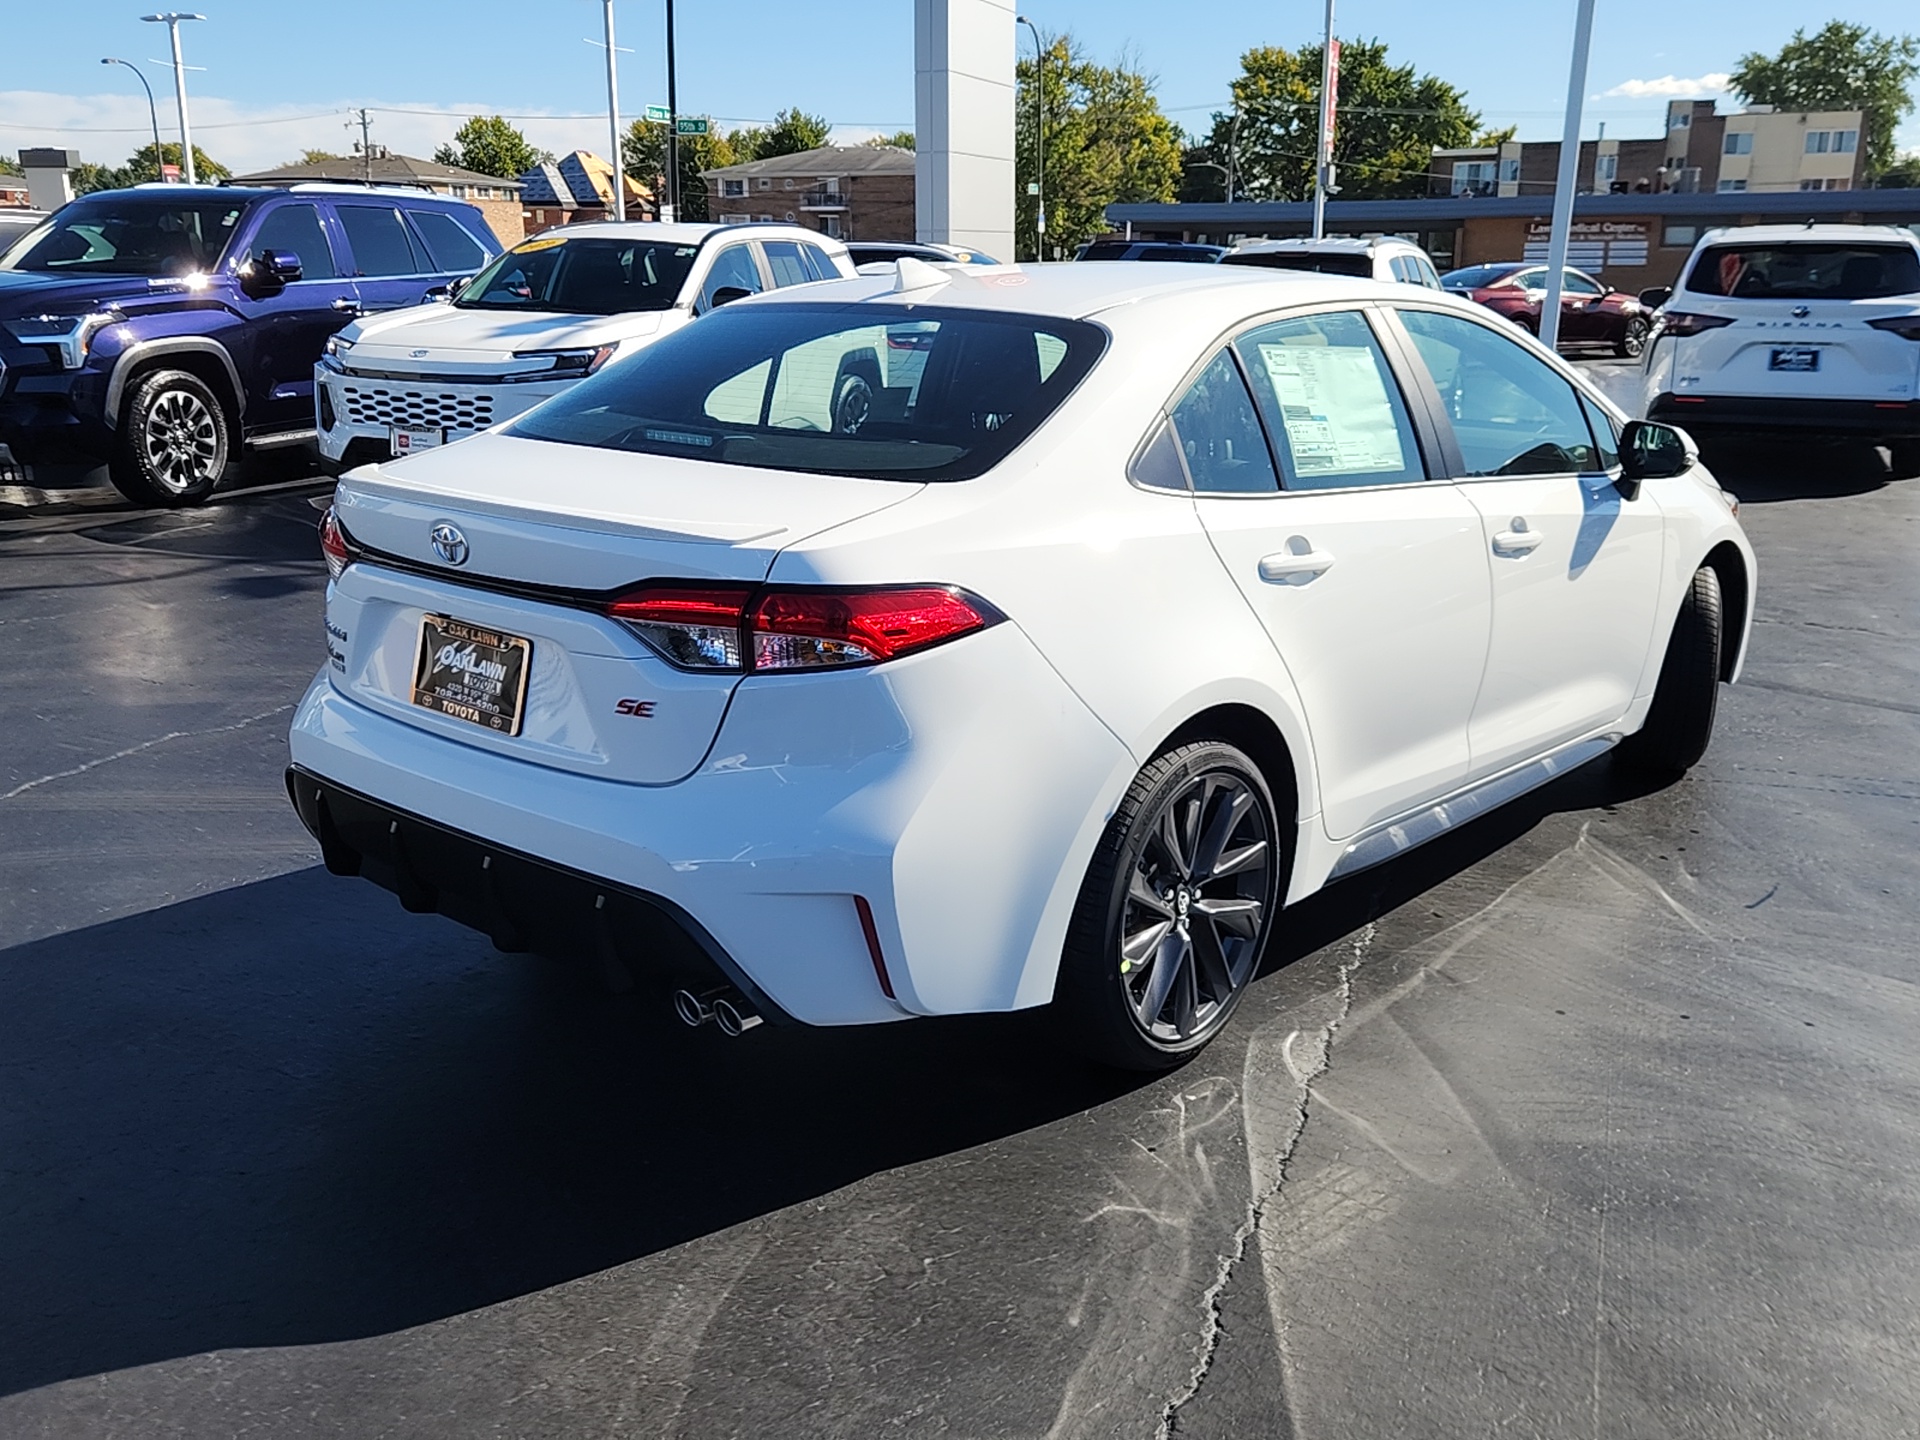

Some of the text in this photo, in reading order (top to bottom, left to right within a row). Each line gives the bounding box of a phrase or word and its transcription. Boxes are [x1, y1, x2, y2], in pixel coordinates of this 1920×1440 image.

[679, 122, 705, 131] 95th St
[1602, 222, 1636, 234] Center
[1756, 321, 1843, 329] SIENNA
[448, 623, 499, 647] OAK LAWN
[442, 700, 480, 722] TOYOTA
[614, 698, 658, 718] SE
